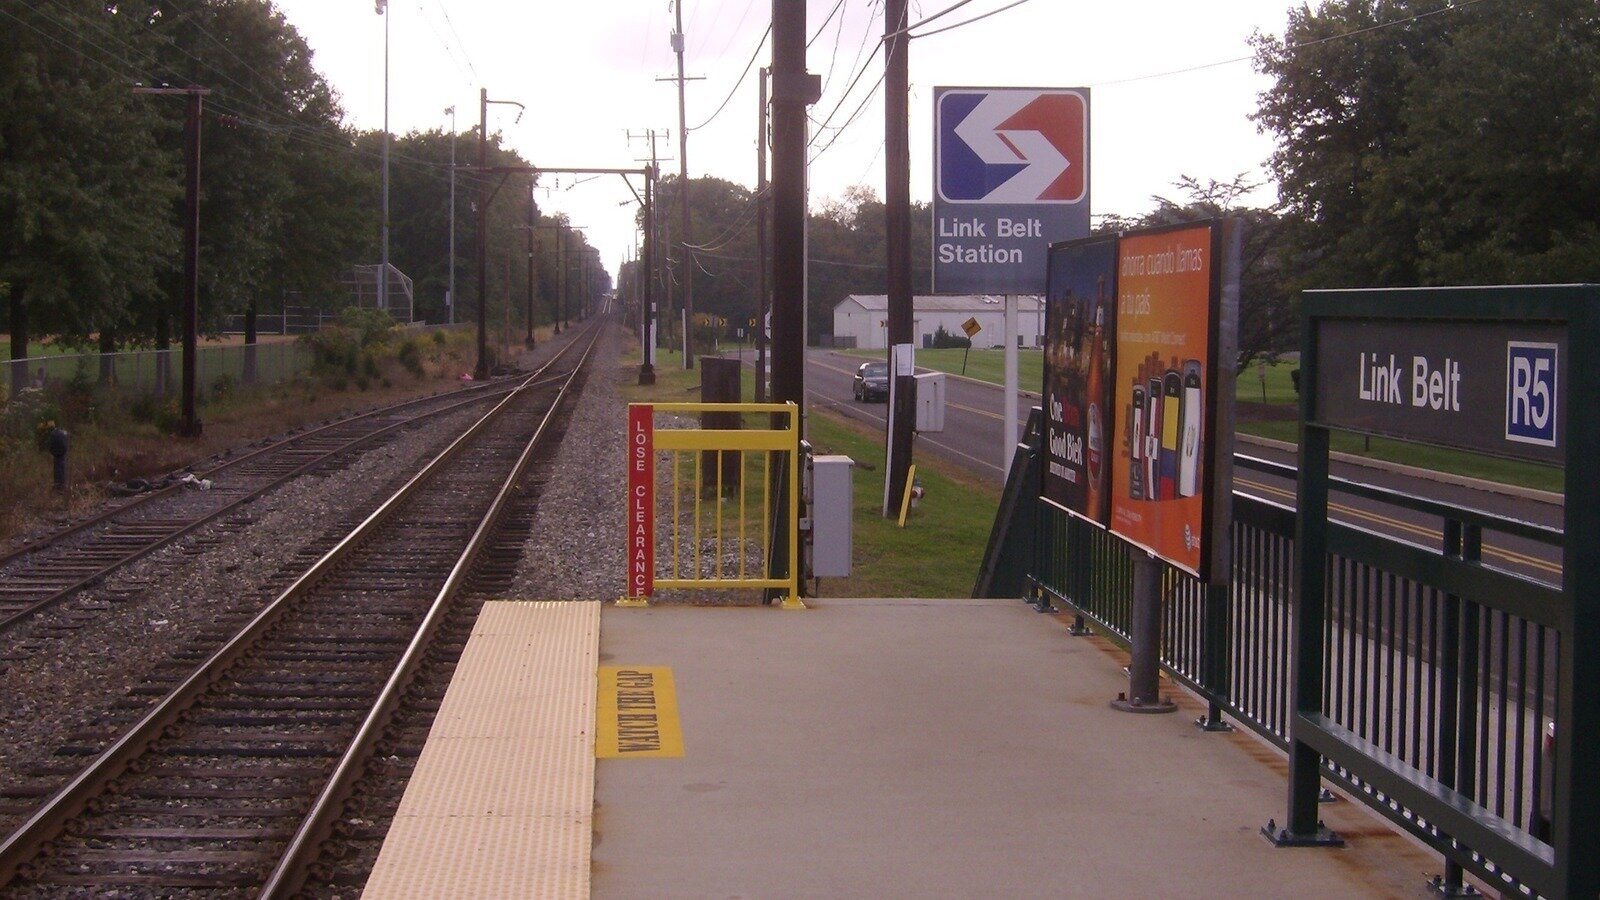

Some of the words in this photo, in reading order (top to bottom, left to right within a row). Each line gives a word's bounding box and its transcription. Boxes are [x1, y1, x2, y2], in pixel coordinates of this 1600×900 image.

[939, 218, 986, 237] Link
[997, 218, 1042, 238] Belt
[938, 243, 1023, 264] Station
[1147, 247, 1174, 275] cuando
[1359, 352, 1402, 405] Link
[1412, 355, 1460, 412] Belt
[1512, 356, 1550, 429] R5
[636, 421, 646, 471] LOSE
[635, 485, 646, 598] CLEARANCE
[616, 670, 654, 689] GAP
[617, 690, 656, 711] THE
[617, 713, 661, 753] WATCH
